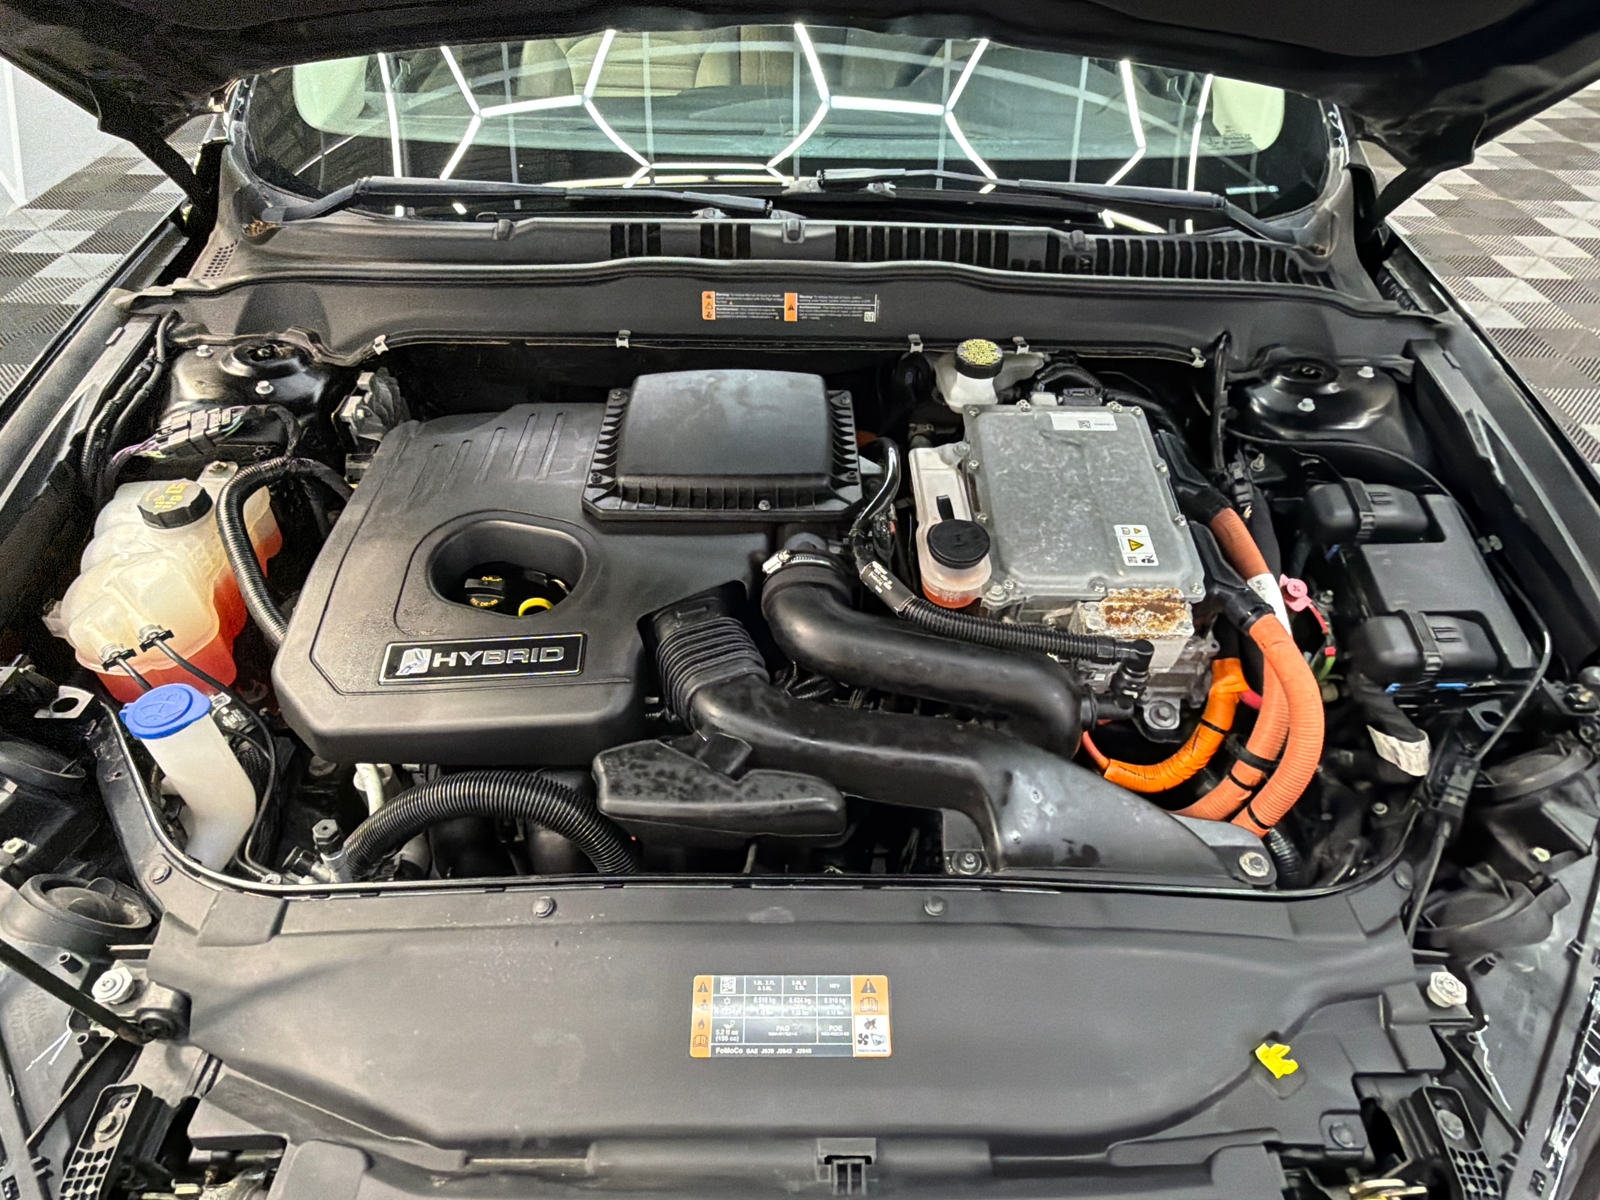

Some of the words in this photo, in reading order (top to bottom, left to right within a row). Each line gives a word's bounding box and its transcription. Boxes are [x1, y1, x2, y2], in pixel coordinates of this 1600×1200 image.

[432, 646, 565, 667] HYBRID
[715, 1028, 725, 1036] 5.2
[775, 1024, 791, 1032] PAG
[828, 1024, 843, 1032] POE
[730, 1035, 740, 1043] cc)
[715, 1046, 744, 1055] FoMoCo
[745, 1047, 759, 1055] SAE
